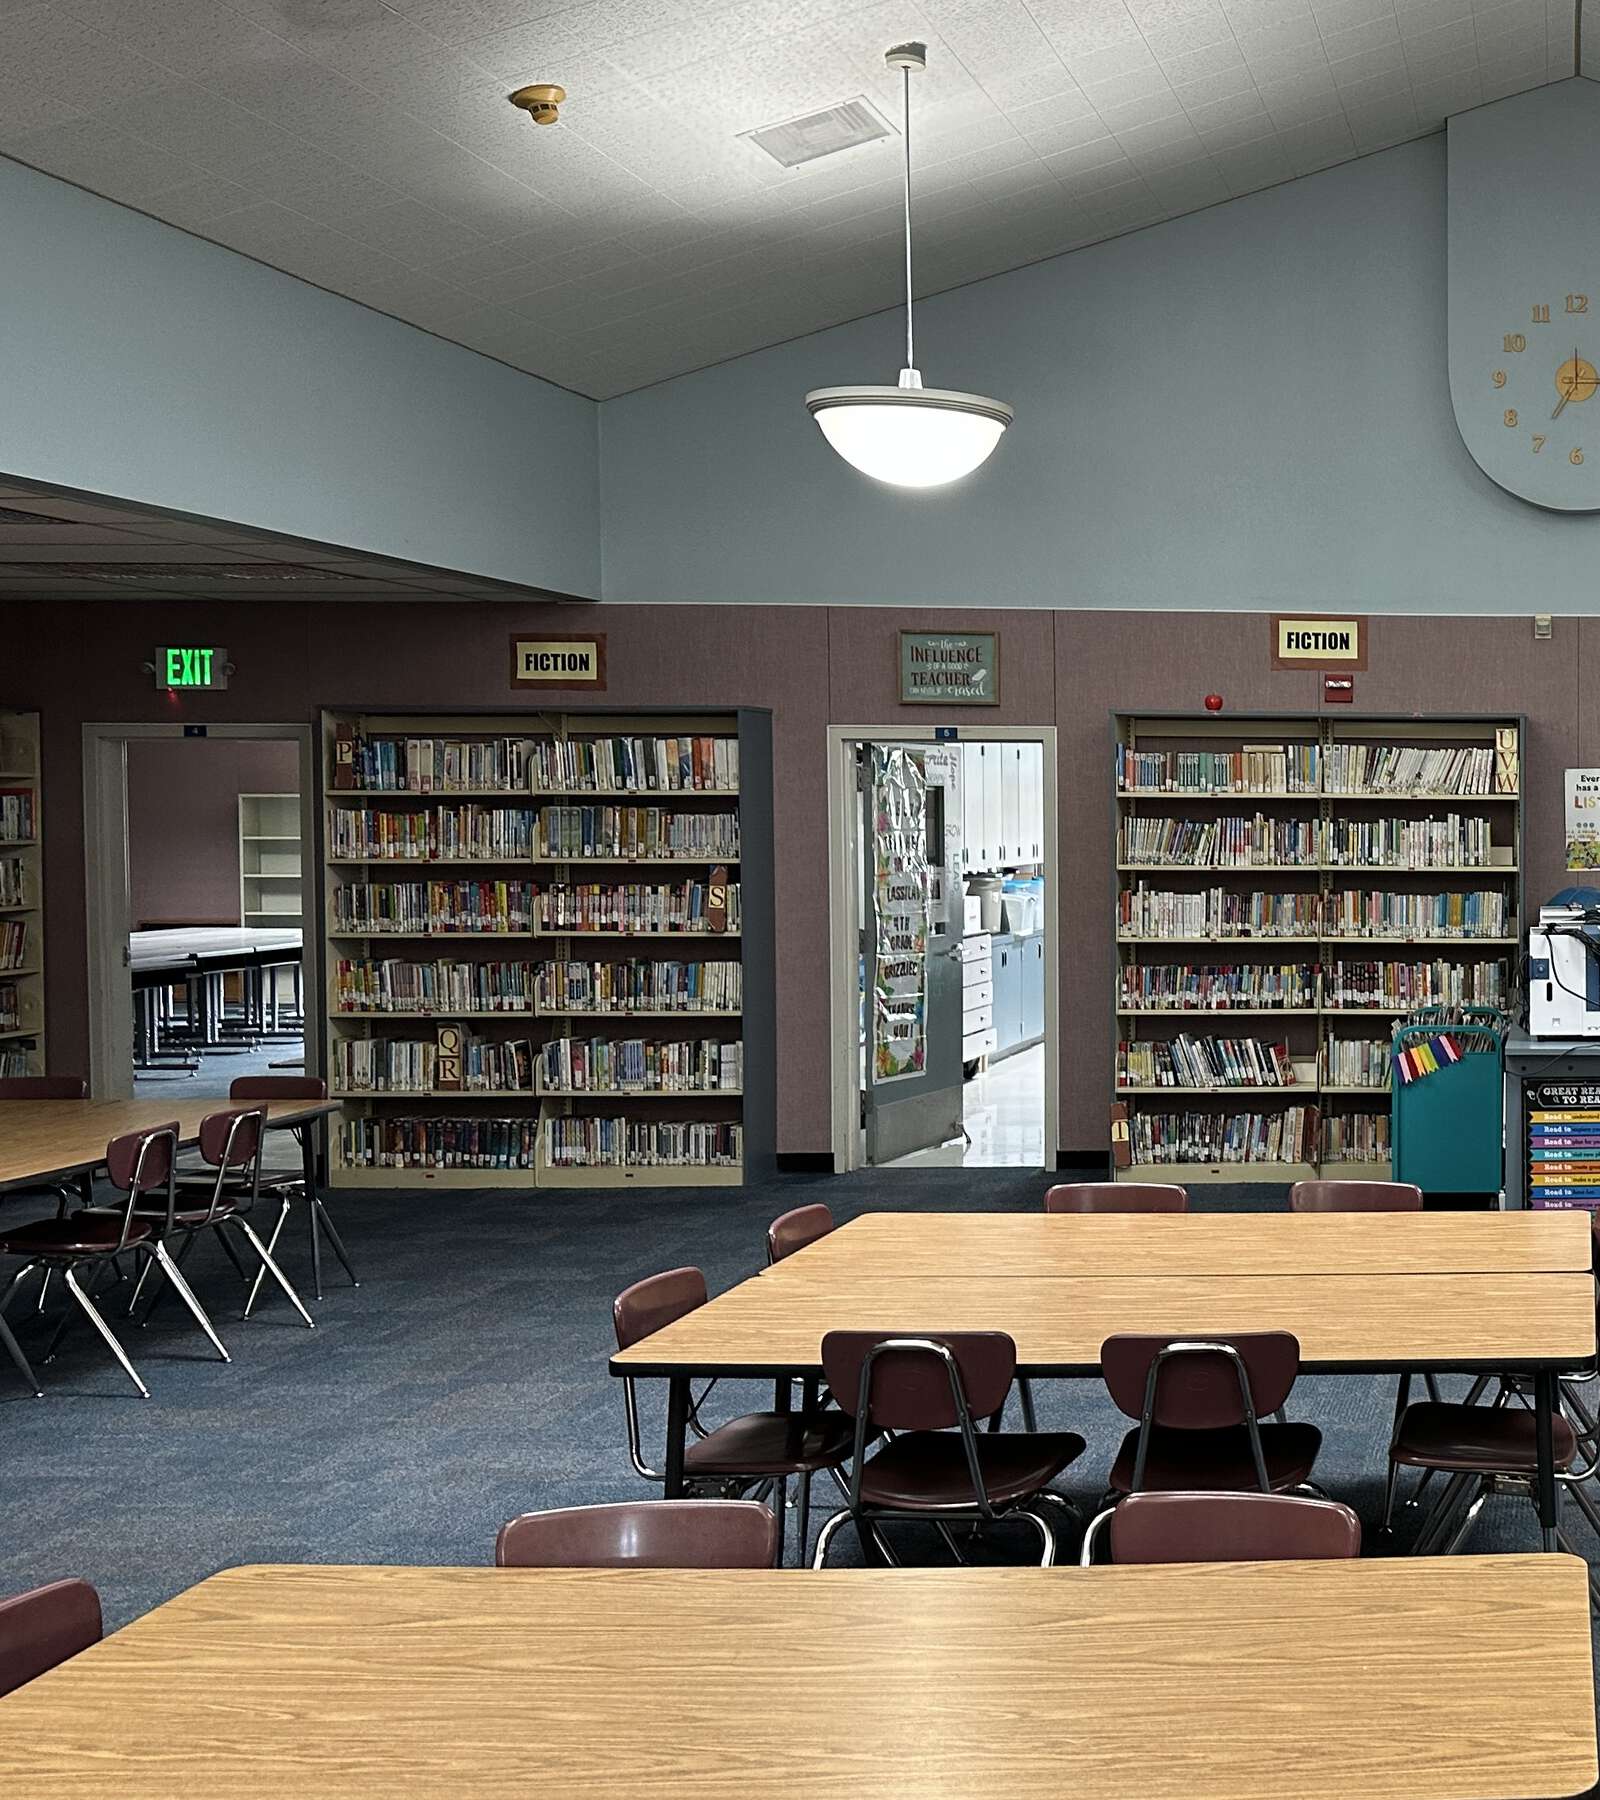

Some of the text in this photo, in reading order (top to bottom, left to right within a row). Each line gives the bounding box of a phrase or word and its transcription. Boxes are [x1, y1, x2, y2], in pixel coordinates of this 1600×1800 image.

[1565, 294, 1589, 313] 12
[1531, 304, 1551, 323] 11
[1503, 334, 1526, 353] 10
[1491, 369, 1507, 388] 9
[1503, 409, 1518, 427] 8
[1532, 435, 1546, 454] 7
[1569, 447, 1584, 465] 6
[1287, 632, 1349, 650] FICTION
[525, 653, 589, 671] FICTION
[911, 645, 984, 662] INFLUENCE
[167, 649, 213, 685] EXIT
[911, 672, 971, 686] TEACHER
[1499, 730, 1514, 750] U
[339, 743, 351, 761] P
[1499, 752, 1516, 770] V
[1497, 773, 1518, 792] W
[711, 887, 724, 906] S
[440, 1029, 459, 1054] Q
[441, 1060, 459, 1078] R
[1543, 1087, 1578, 1096] GREAT
[1562, 1096, 1577, 1104] TO
